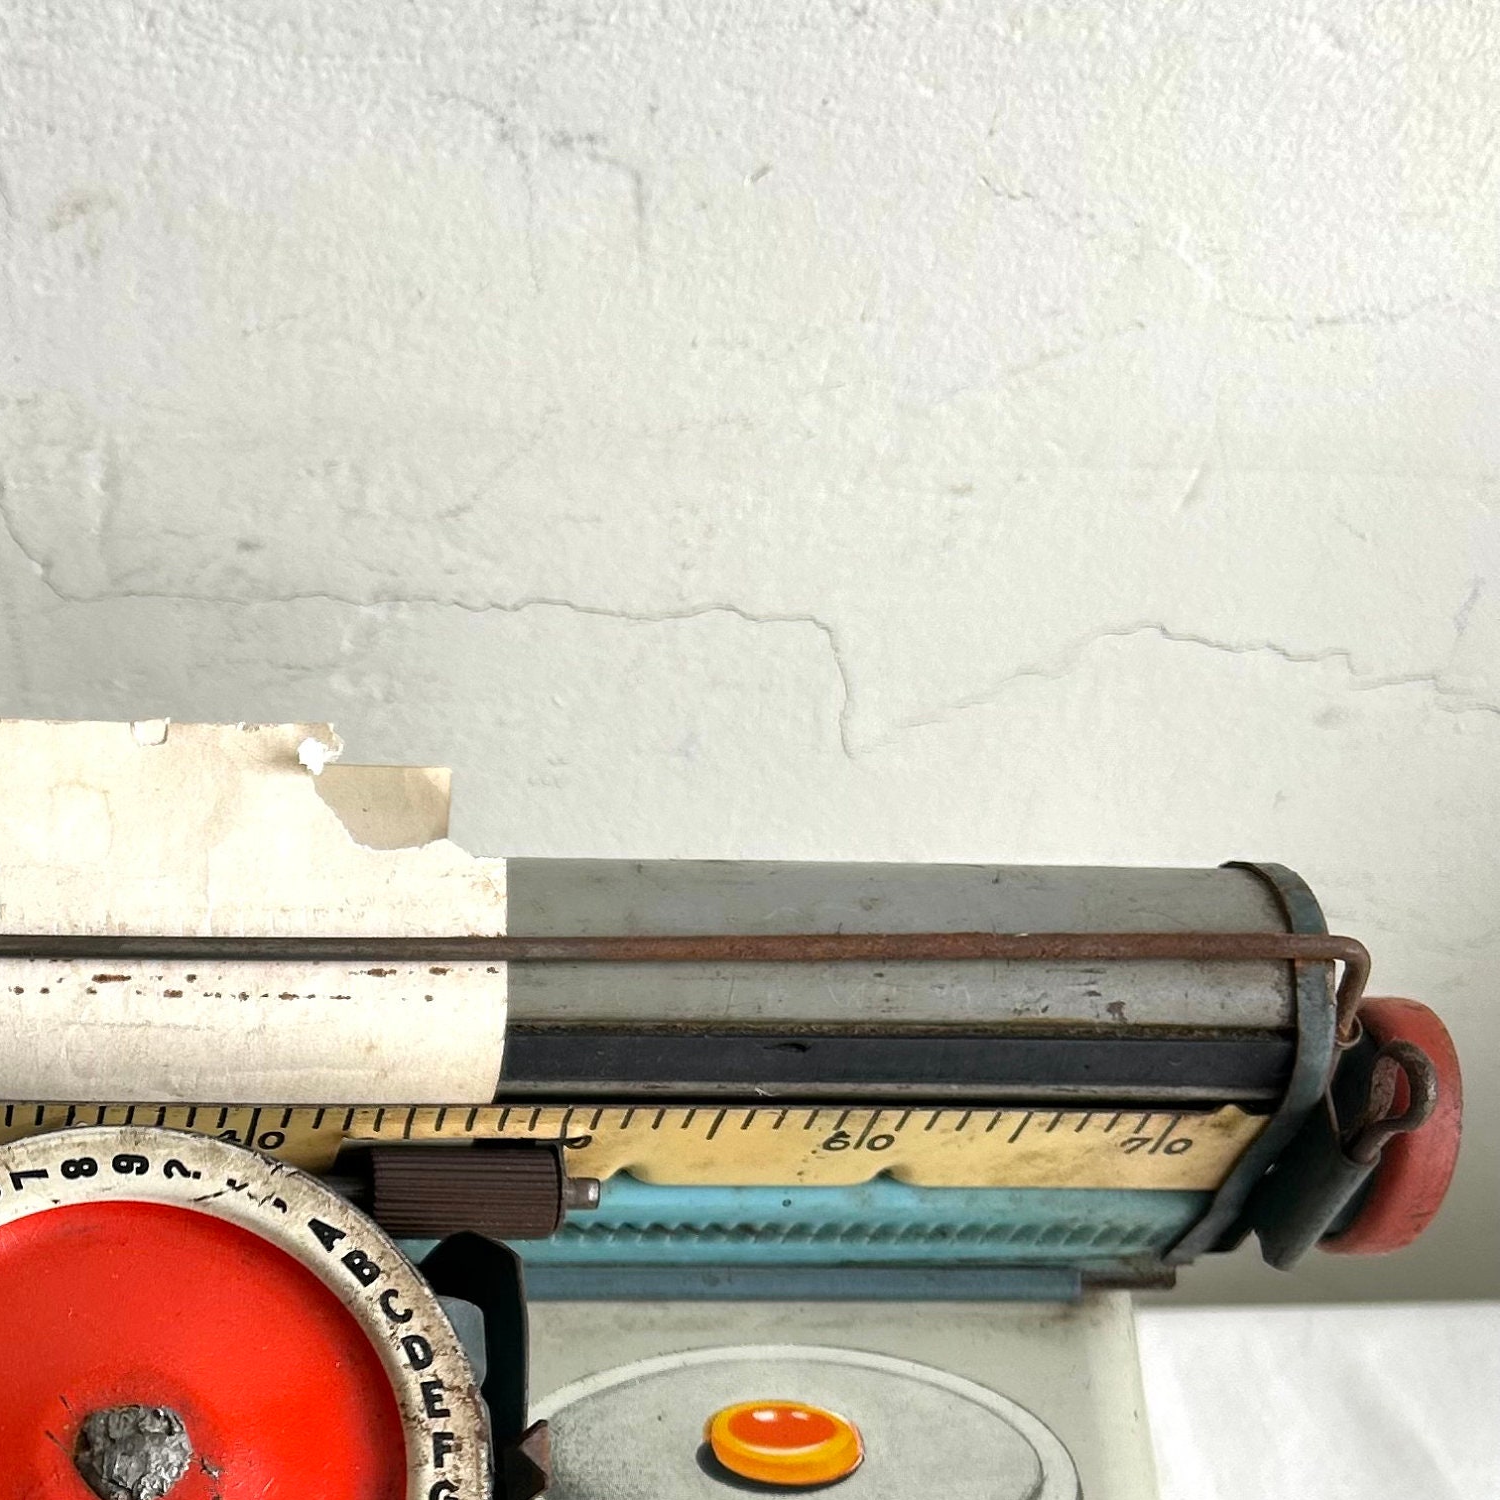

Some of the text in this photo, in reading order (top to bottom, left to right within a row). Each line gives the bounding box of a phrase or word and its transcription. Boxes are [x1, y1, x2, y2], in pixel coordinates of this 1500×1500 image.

[9, 1168, 49, 1191] 7
[61, 1157, 98, 1179] 8
[308, 1218, 346, 1252] A
[341, 1250, 381, 1287] B
[380, 1289, 413, 1324] C
[400, 1335, 437, 1371] D
[420, 1380, 450, 1418] E
[432, 1432, 454, 1468] F
